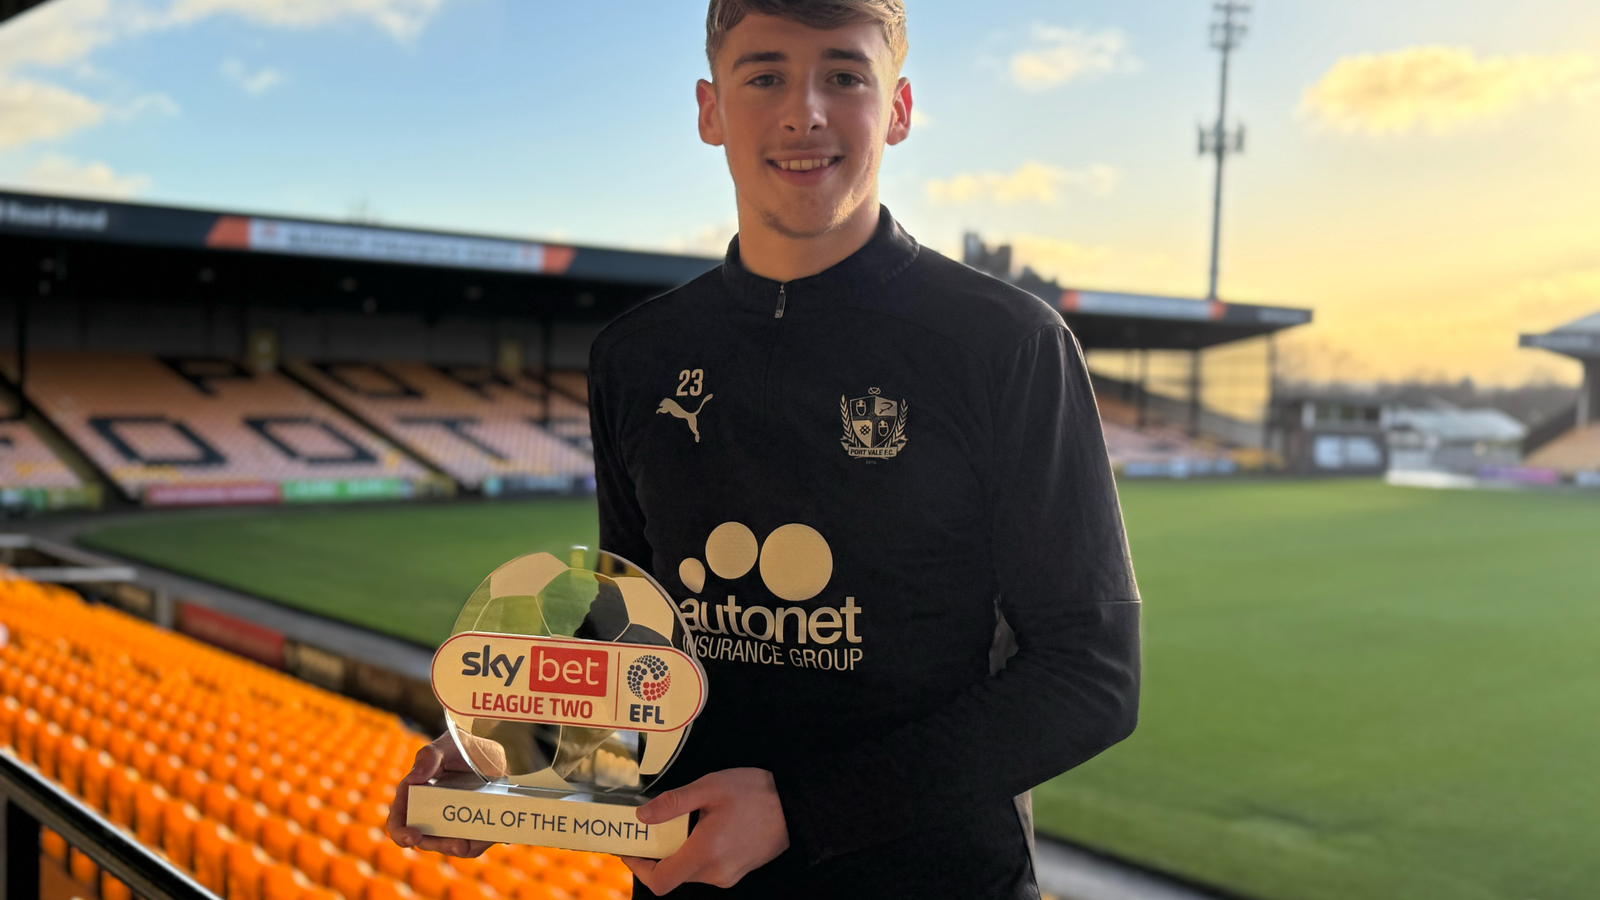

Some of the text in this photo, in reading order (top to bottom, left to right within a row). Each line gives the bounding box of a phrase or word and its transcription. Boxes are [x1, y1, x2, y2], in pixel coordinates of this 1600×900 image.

[676, 368, 704, 397] 23
[850, 448, 867, 456] PORT
[867, 448, 883, 456] VALE
[679, 595, 863, 645] autonet
[461, 644, 600, 687] sky bet
[789, 647, 864, 671] GROUP
[471, 691, 594, 719] LEAGUE TWO
[629, 703, 665, 725] EFL
[442, 804, 649, 841] GOAL OF THE MONTH
